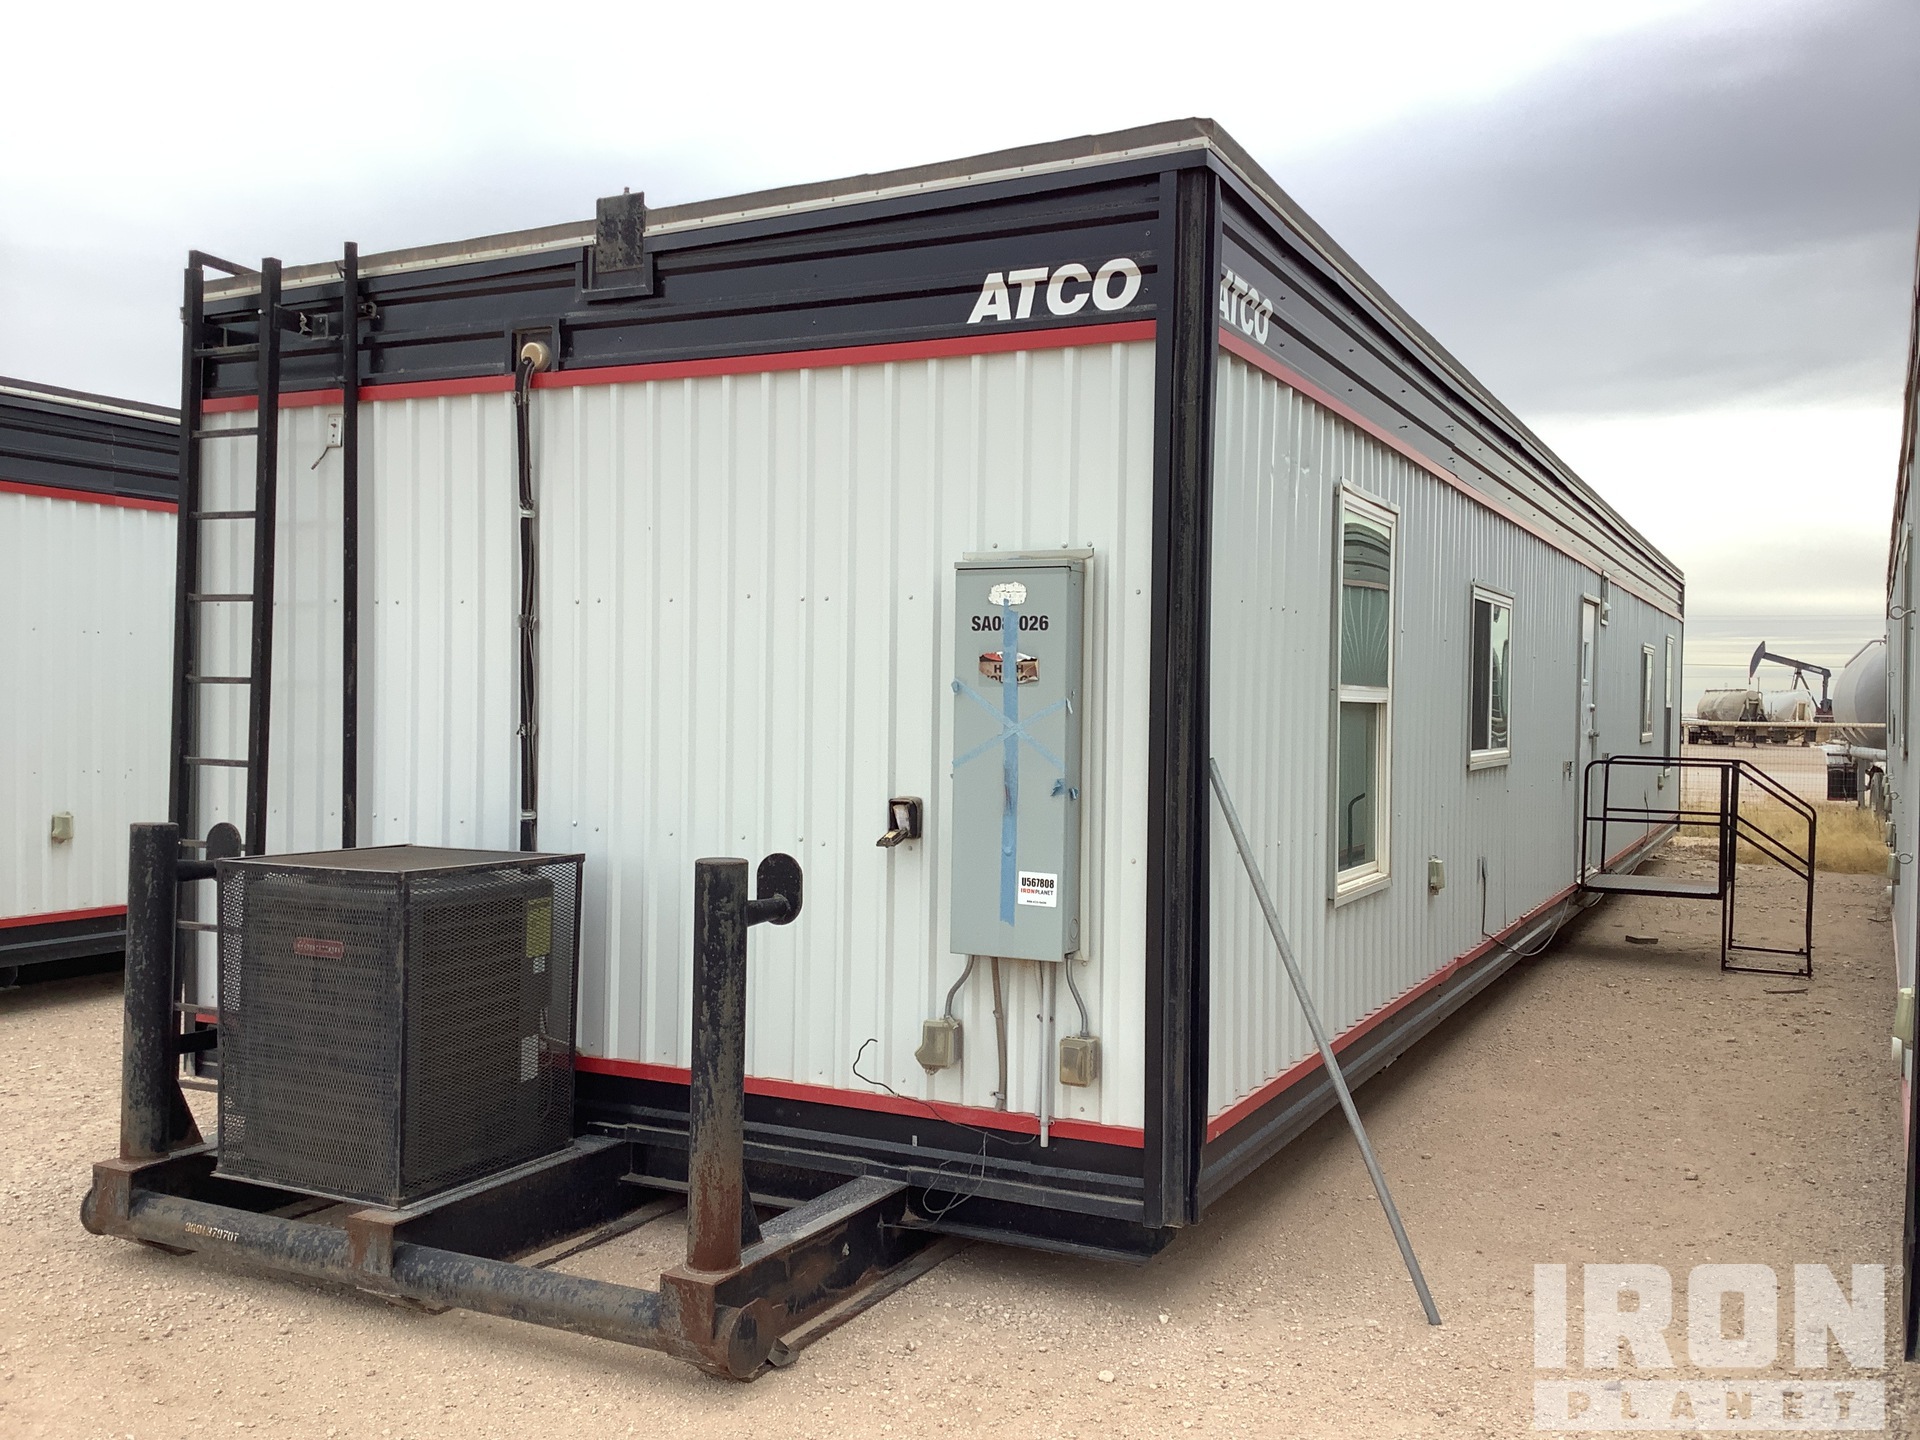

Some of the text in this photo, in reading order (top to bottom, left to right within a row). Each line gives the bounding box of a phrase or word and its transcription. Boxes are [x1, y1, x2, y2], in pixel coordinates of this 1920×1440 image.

[966, 257, 1142, 324] ATCO
[1219, 269, 1274, 345] ATCO
[1021, 877, 1055, 889] U567808
